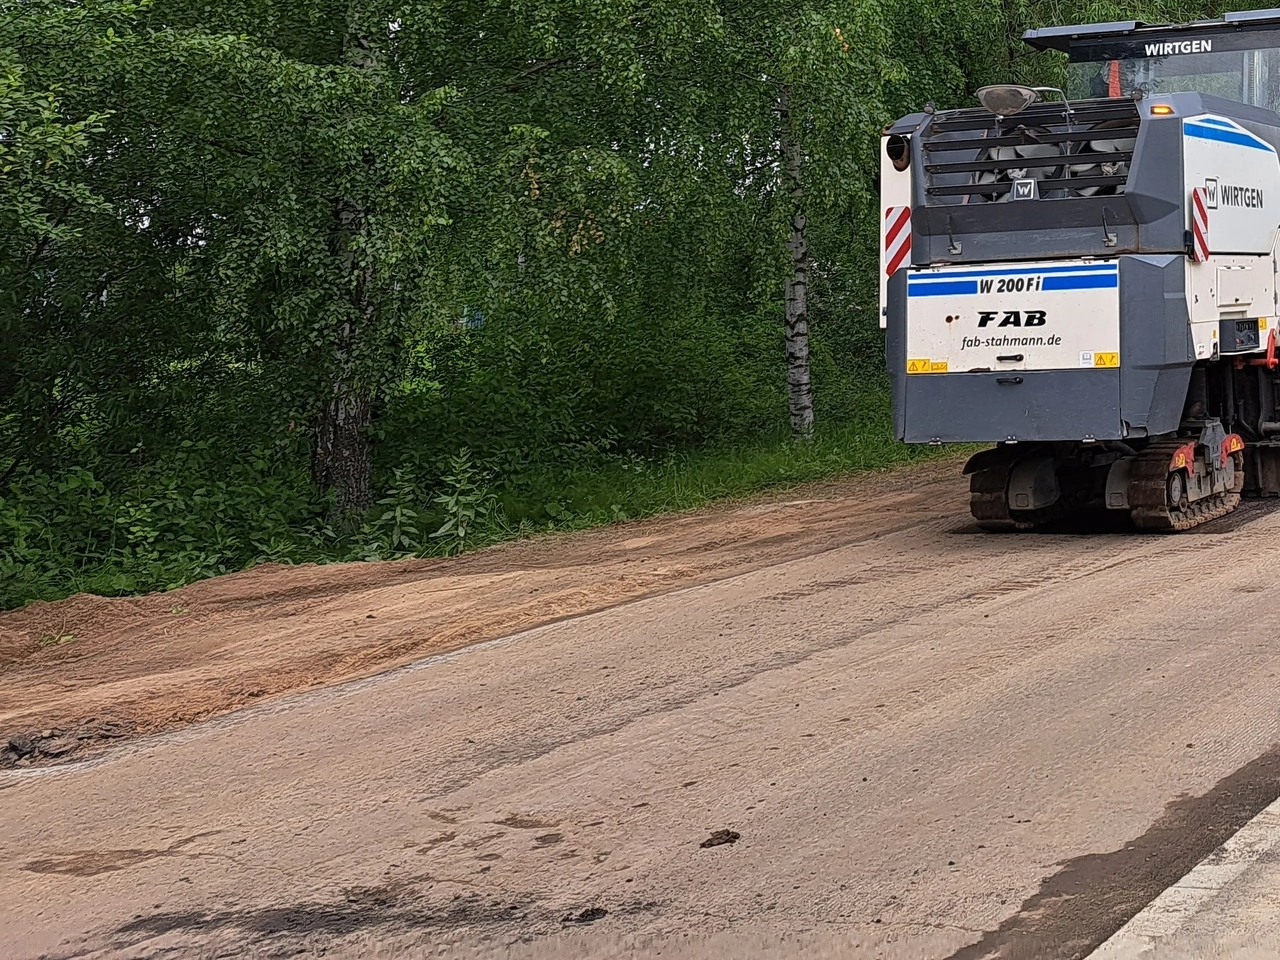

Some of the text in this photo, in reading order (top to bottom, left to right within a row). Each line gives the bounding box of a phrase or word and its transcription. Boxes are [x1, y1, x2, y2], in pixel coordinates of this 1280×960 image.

[1144, 39, 1212, 57] WIRTGEN
[1220, 184, 1264, 209] WIRTGEN
[980, 279, 994, 294] W
[977, 310, 1047, 328] FAB
[961, 333, 1062, 350] fab-stahmann.de
